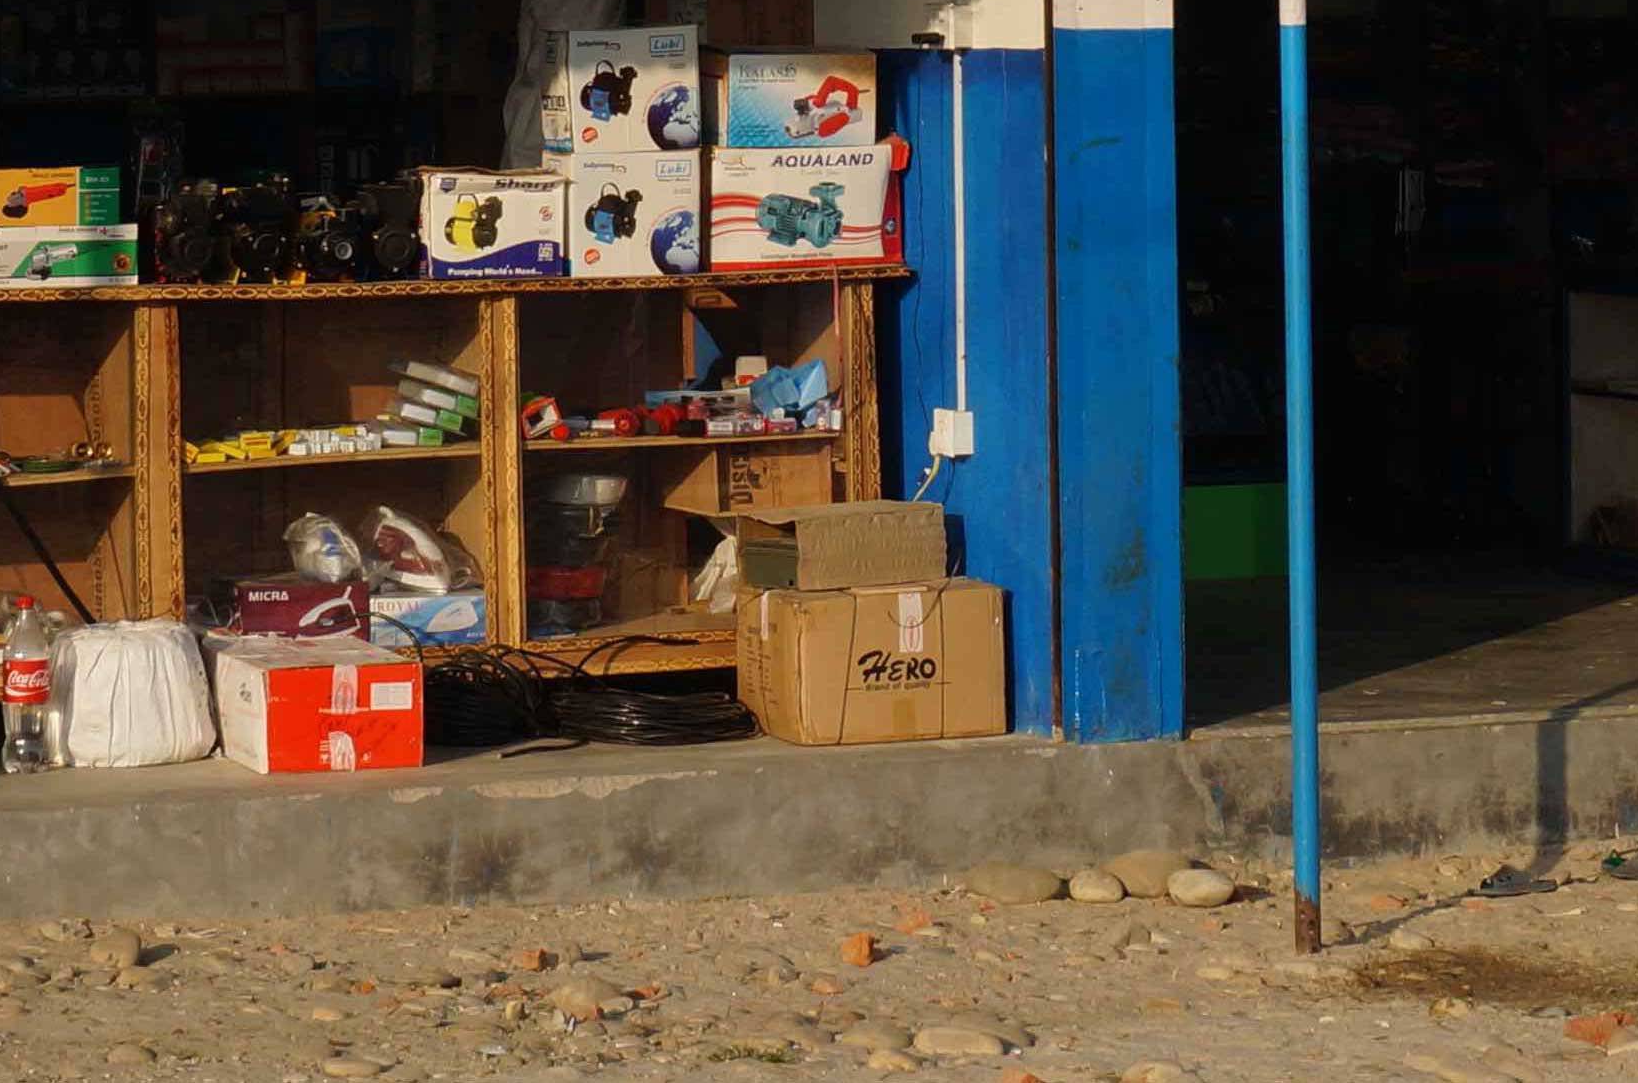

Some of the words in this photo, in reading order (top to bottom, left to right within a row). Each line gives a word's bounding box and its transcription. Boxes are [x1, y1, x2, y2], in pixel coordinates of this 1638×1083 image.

[653, 38, 681, 51] Lubi
[772, 153, 873, 167] AQUALAND
[659, 163, 688, 176] Lubi
[494, 178, 556, 190] Sharp
[249, 591, 288, 601] MICRA
[858, 650, 938, 684] HERO
